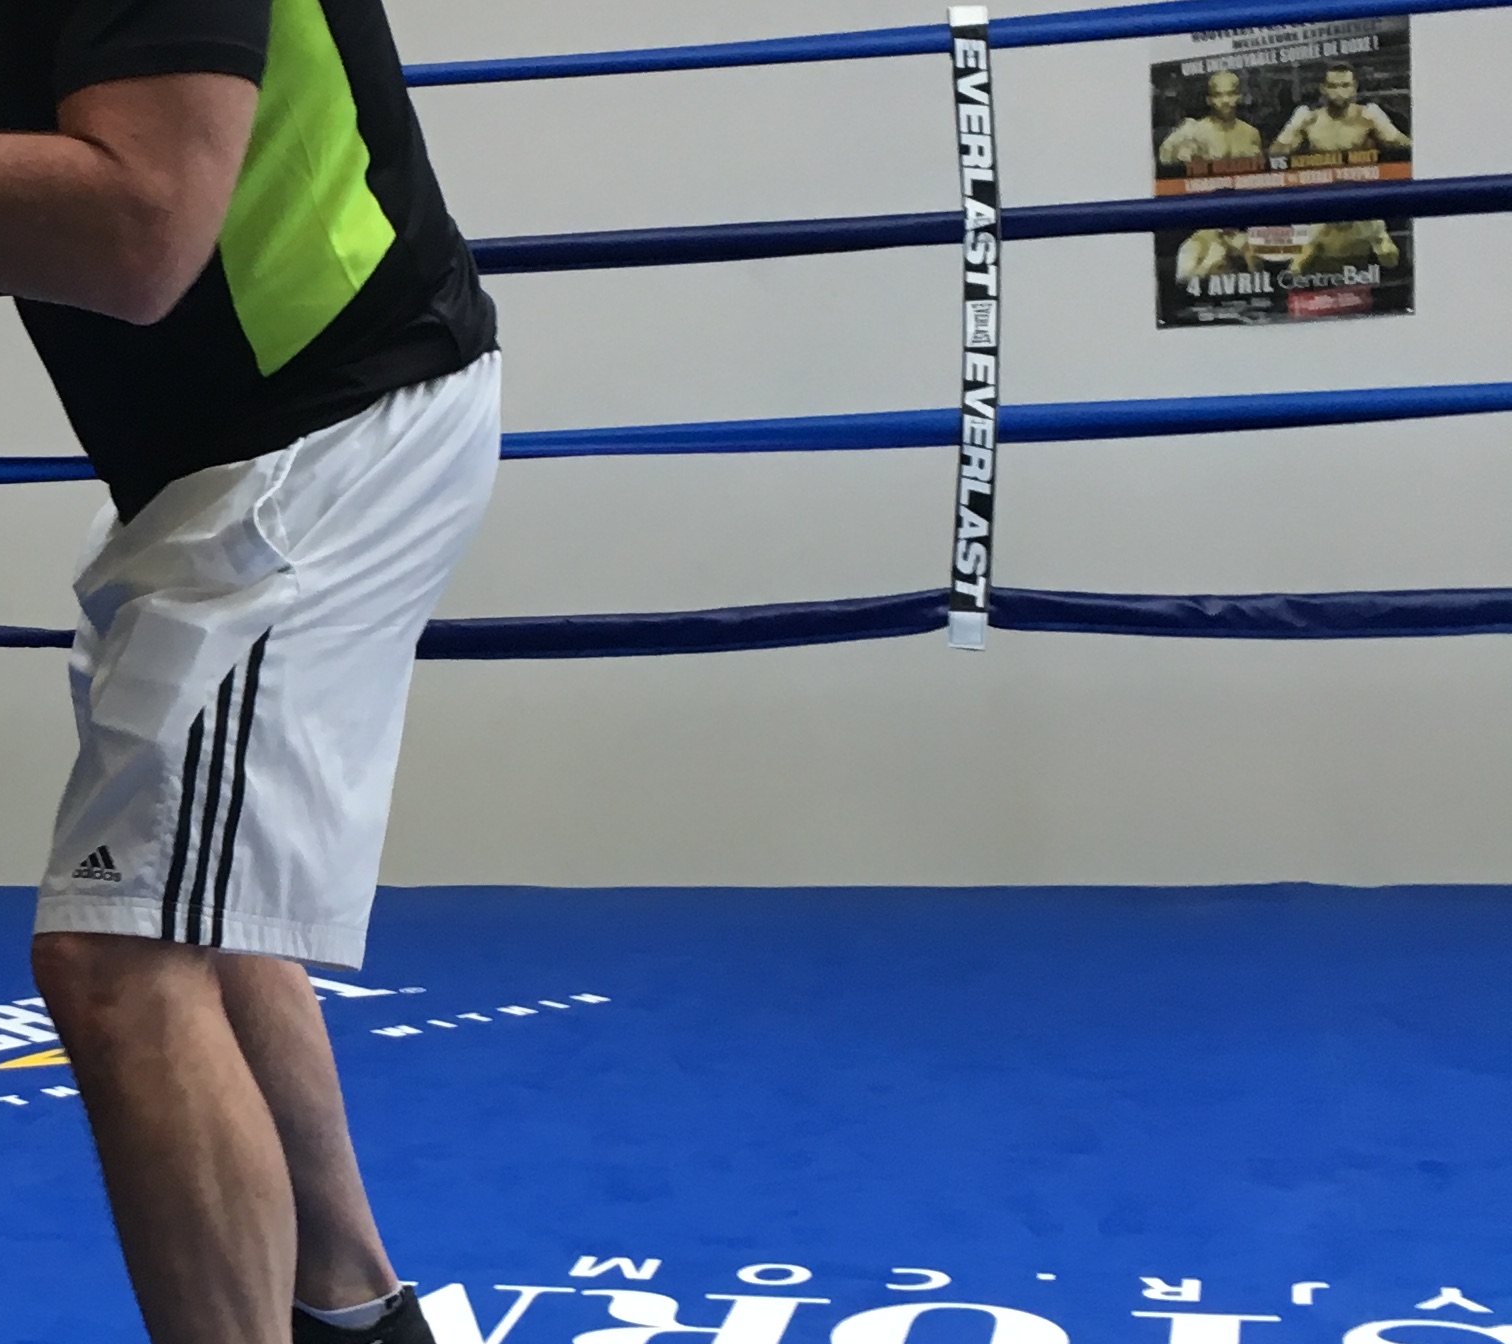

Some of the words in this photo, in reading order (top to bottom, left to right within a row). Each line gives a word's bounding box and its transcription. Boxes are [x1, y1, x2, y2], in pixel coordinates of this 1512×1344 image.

[952, 36, 997, 297] EVERLAST
[1186, 275, 1202, 297] 4
[1208, 270, 1274, 296] AVRIL
[953, 352, 996, 609] EVERLAST
[369, 993, 612, 1037] WITHIN
